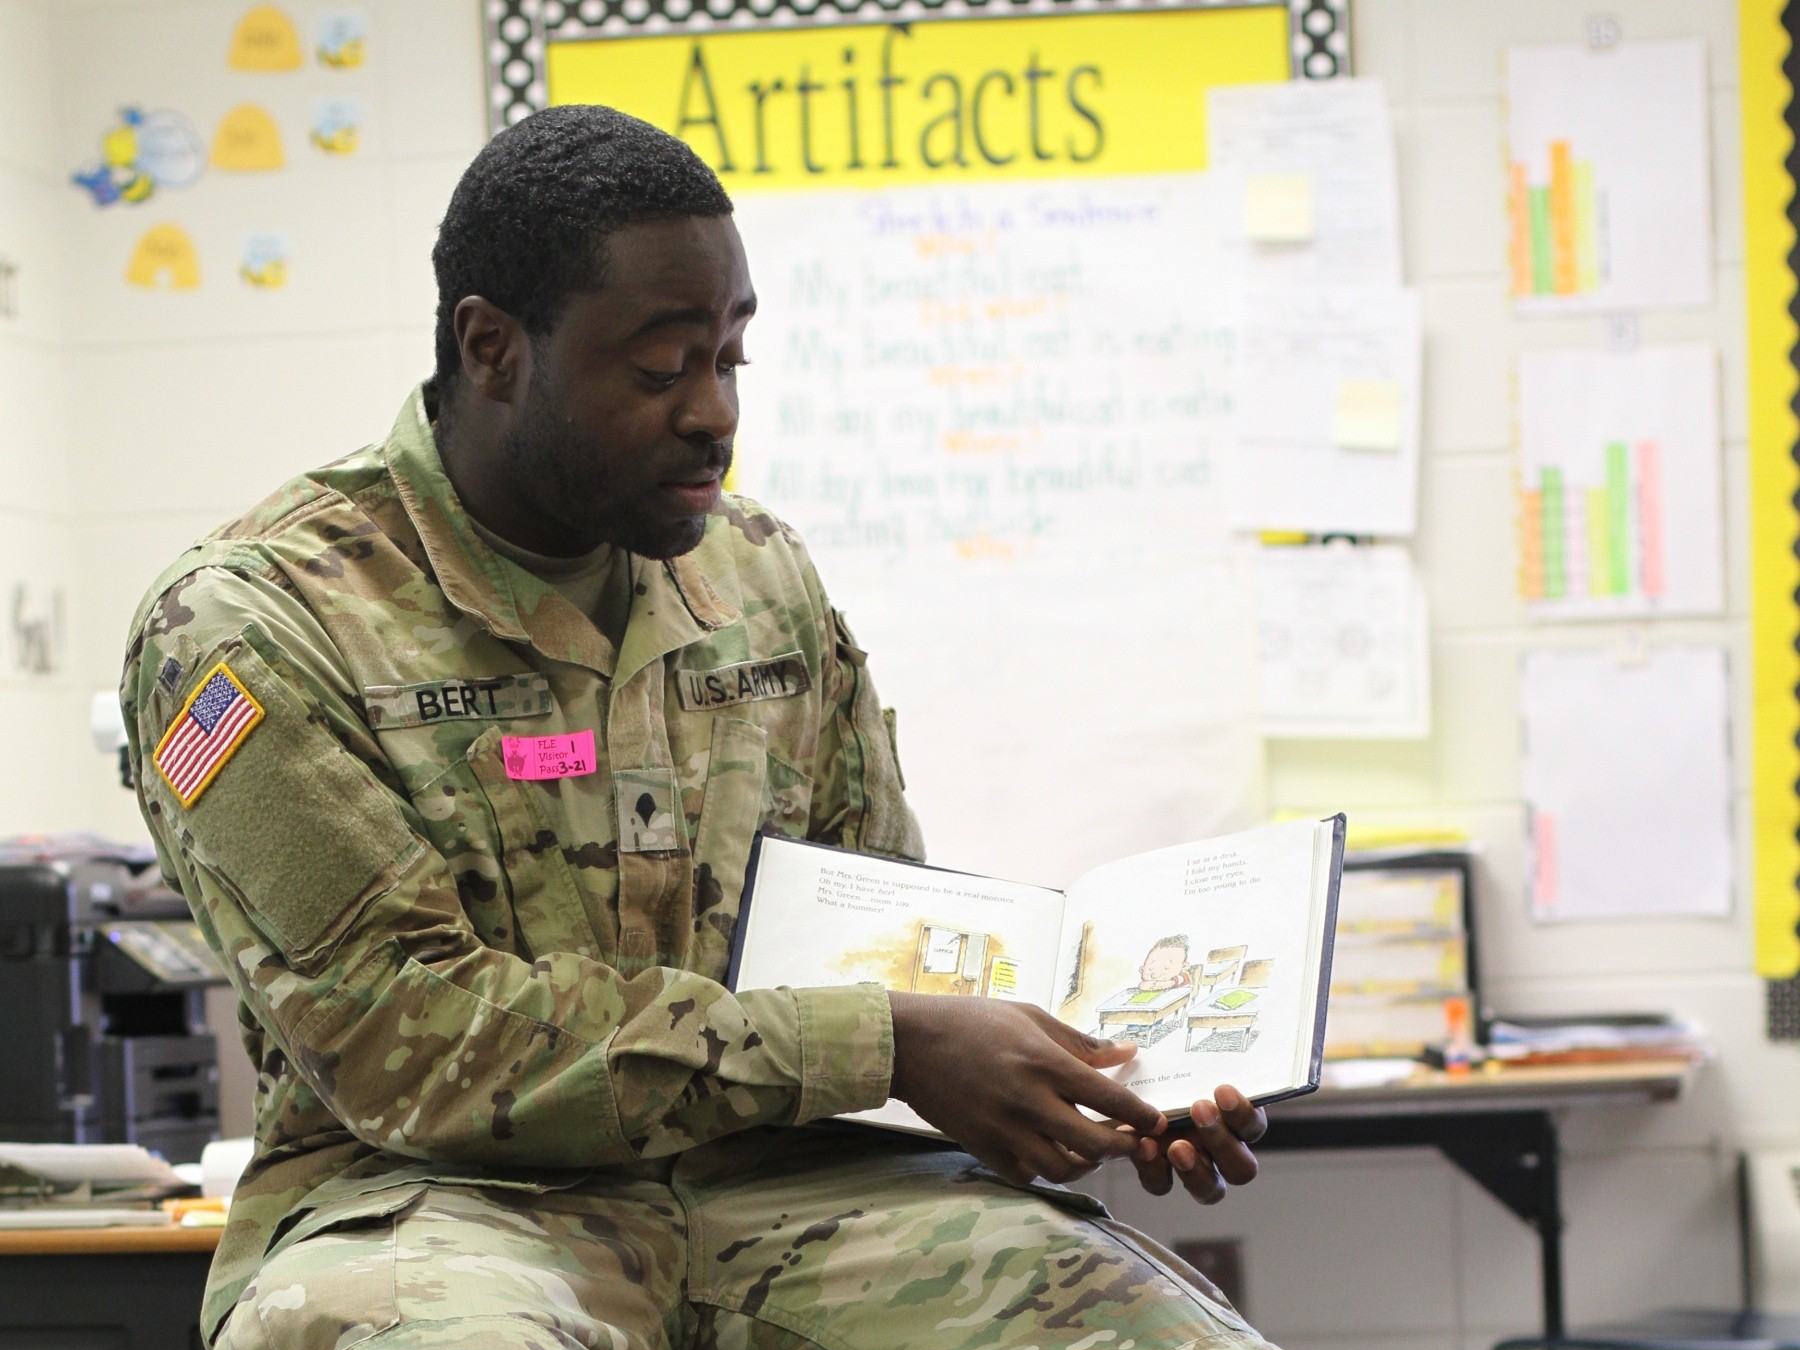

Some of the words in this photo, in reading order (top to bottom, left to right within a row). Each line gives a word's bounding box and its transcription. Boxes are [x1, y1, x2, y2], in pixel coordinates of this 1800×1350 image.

[675, 21, 1106, 174] Artifacts
[689, 673, 736, 706] U.S.
[737, 661, 789, 699] ARMY
[415, 685, 499, 721] BERT
[538, 739, 557, 750] FLE
[538, 752, 568, 762] Visitor
[540, 765, 560, 774] Pass
[558, 759, 587, 775] 3-21
[1191, 867, 1206, 875] fold
[820, 867, 834, 876] But
[856, 875, 880, 884] Green
[892, 882, 930, 892] supposed
[1190, 877, 1209, 885] close
[1213, 881, 1237, 891] young
[817, 886, 834, 896] Mrs.
[819, 877, 831, 885] Oh
[856, 884, 876, 893] have
[878, 888, 895, 896] her!
[816, 896, 838, 906] What
[848, 903, 885, 914] bummer!
[1131, 1078, 1156, 1087] covers
[1158, 1074, 1171, 1082] the
